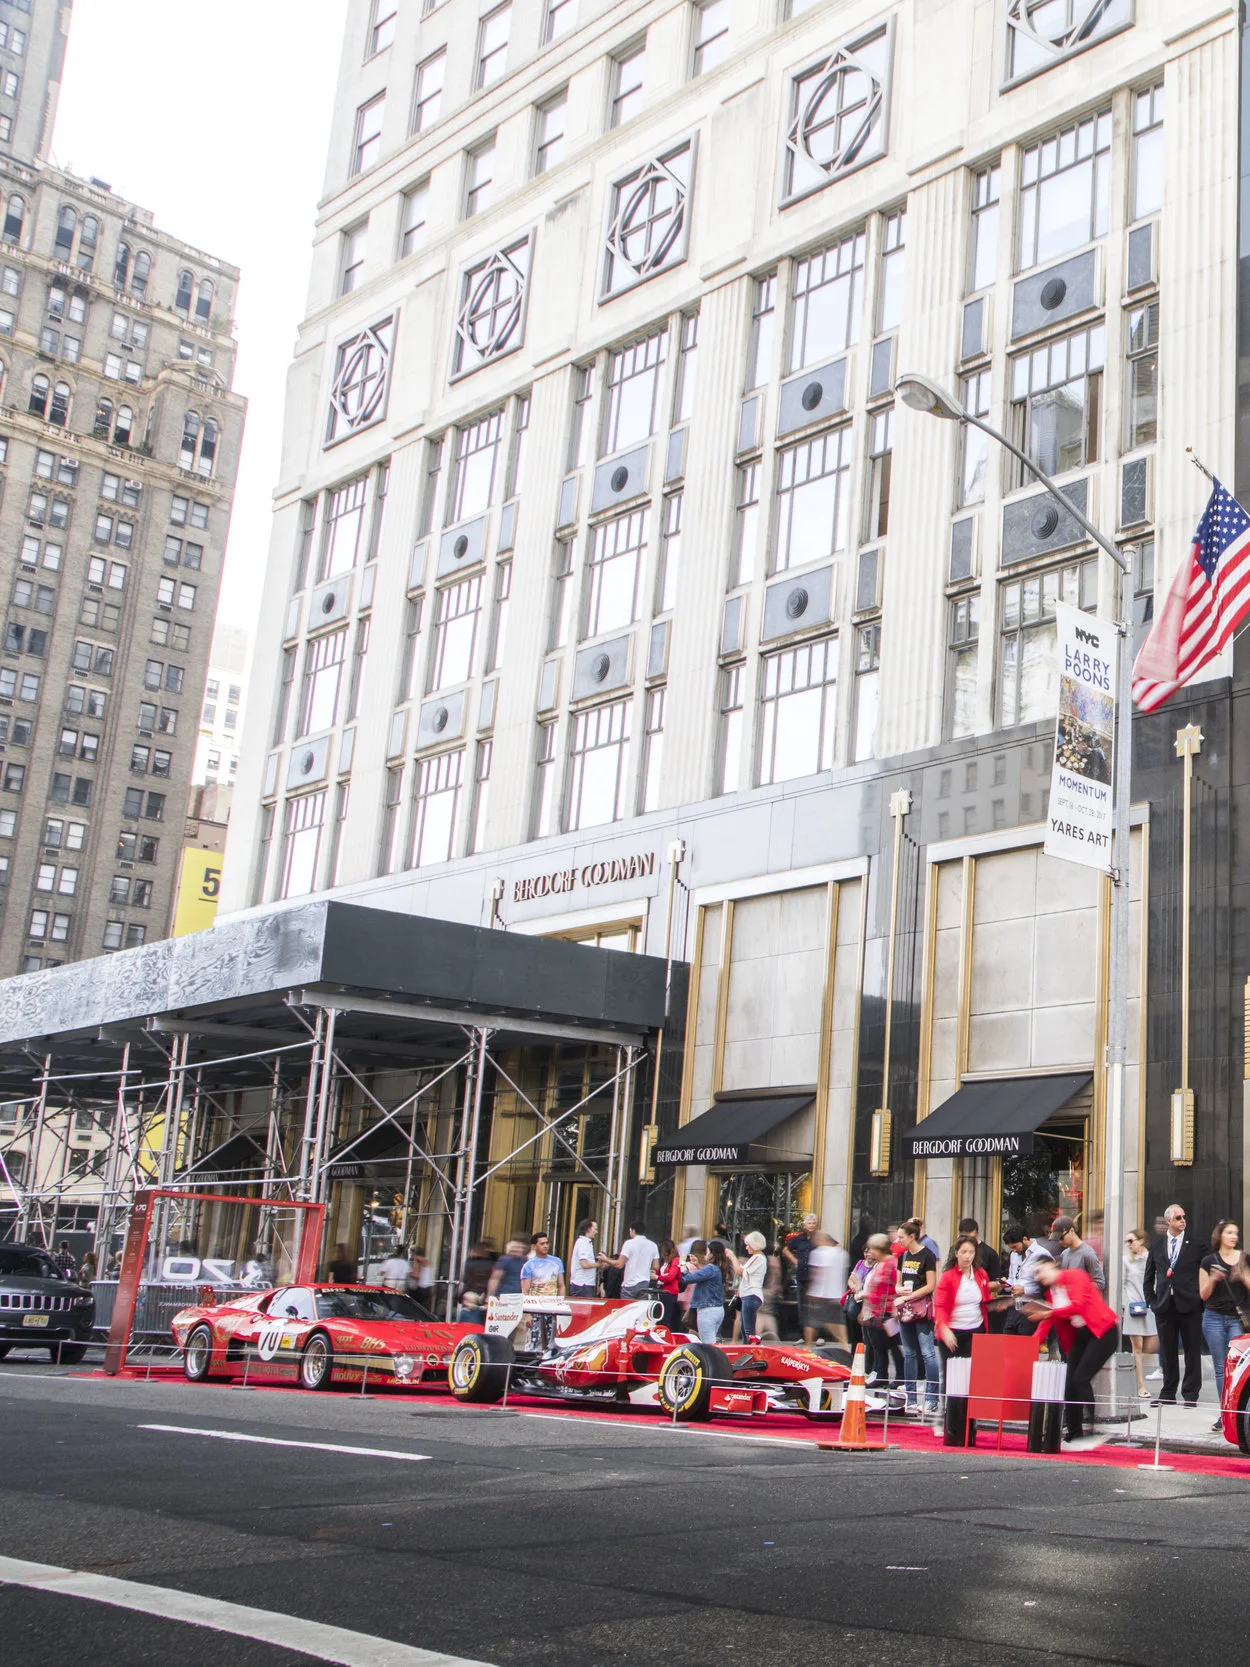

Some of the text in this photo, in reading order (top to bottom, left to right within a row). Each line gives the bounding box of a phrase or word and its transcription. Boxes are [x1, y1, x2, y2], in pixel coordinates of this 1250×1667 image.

[1075, 627, 1099, 648] NYC
[1065, 644, 1110, 675] LARRY
[1065, 658, 1110, 690] POONS
[1059, 775, 1107, 802] MOMENTUM
[1051, 818, 1110, 848] YARES ART
[202, 867, 221, 897] 5
[514, 852, 655, 902] BERGDORF GOODMAN
[657, 1147, 739, 1162] BERGDORF GOODMAN
[913, 1137, 1019, 1155] BERGDORF GOODMAN
[494, 1312, 519, 1322] Santander
